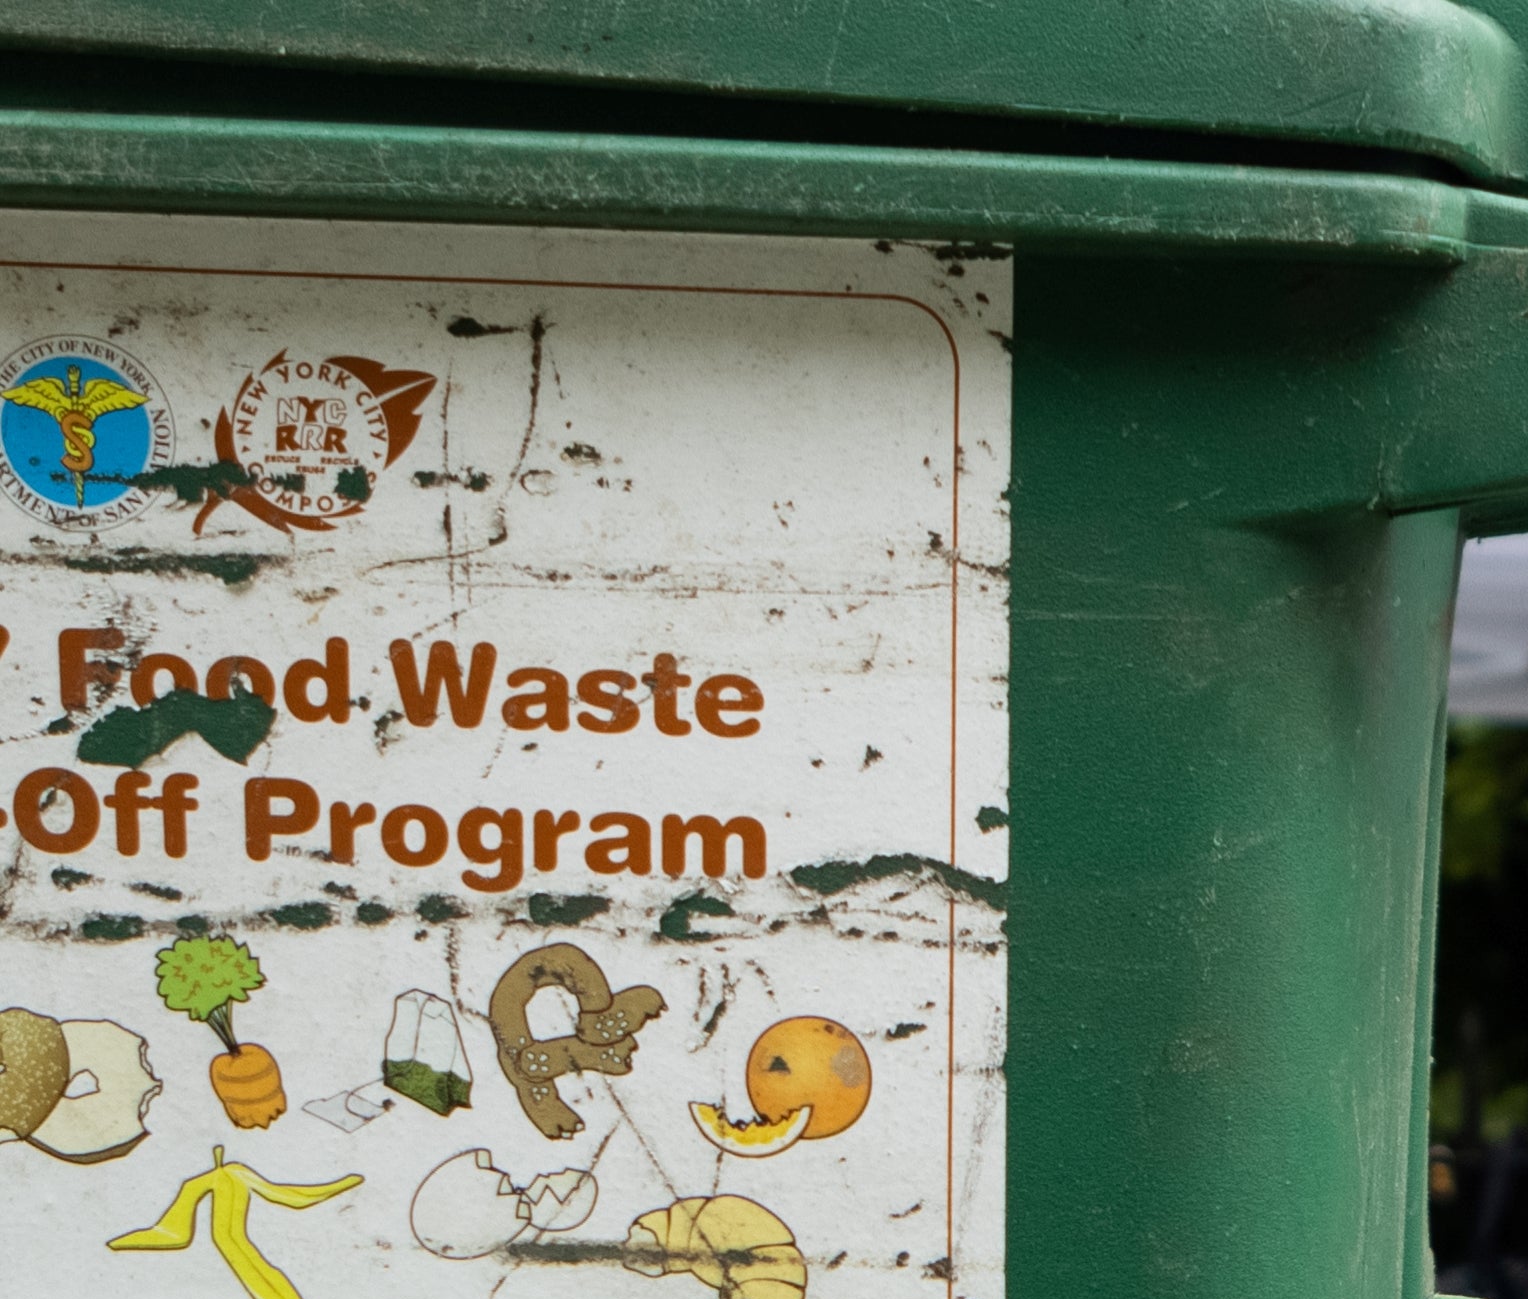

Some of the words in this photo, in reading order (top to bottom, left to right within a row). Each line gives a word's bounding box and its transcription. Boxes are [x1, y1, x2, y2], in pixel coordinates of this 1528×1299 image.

[20, 341, 55, 365] CITY
[58, 340, 79, 354] OF
[81, 341, 120, 363] NEW
[119, 358, 155, 398] YORK
[236, 380, 269, 436] NEW
[275, 361, 352, 391] YORK
[355, 390, 388, 443] CITY
[275, 423, 348, 454] RRR
[276, 395, 348, 427] NYC
[58, 627, 350, 724] Food
[388, 637, 765, 738] Waste
[0, 767, 199, 859] Off
[244, 777, 767, 893] Program
